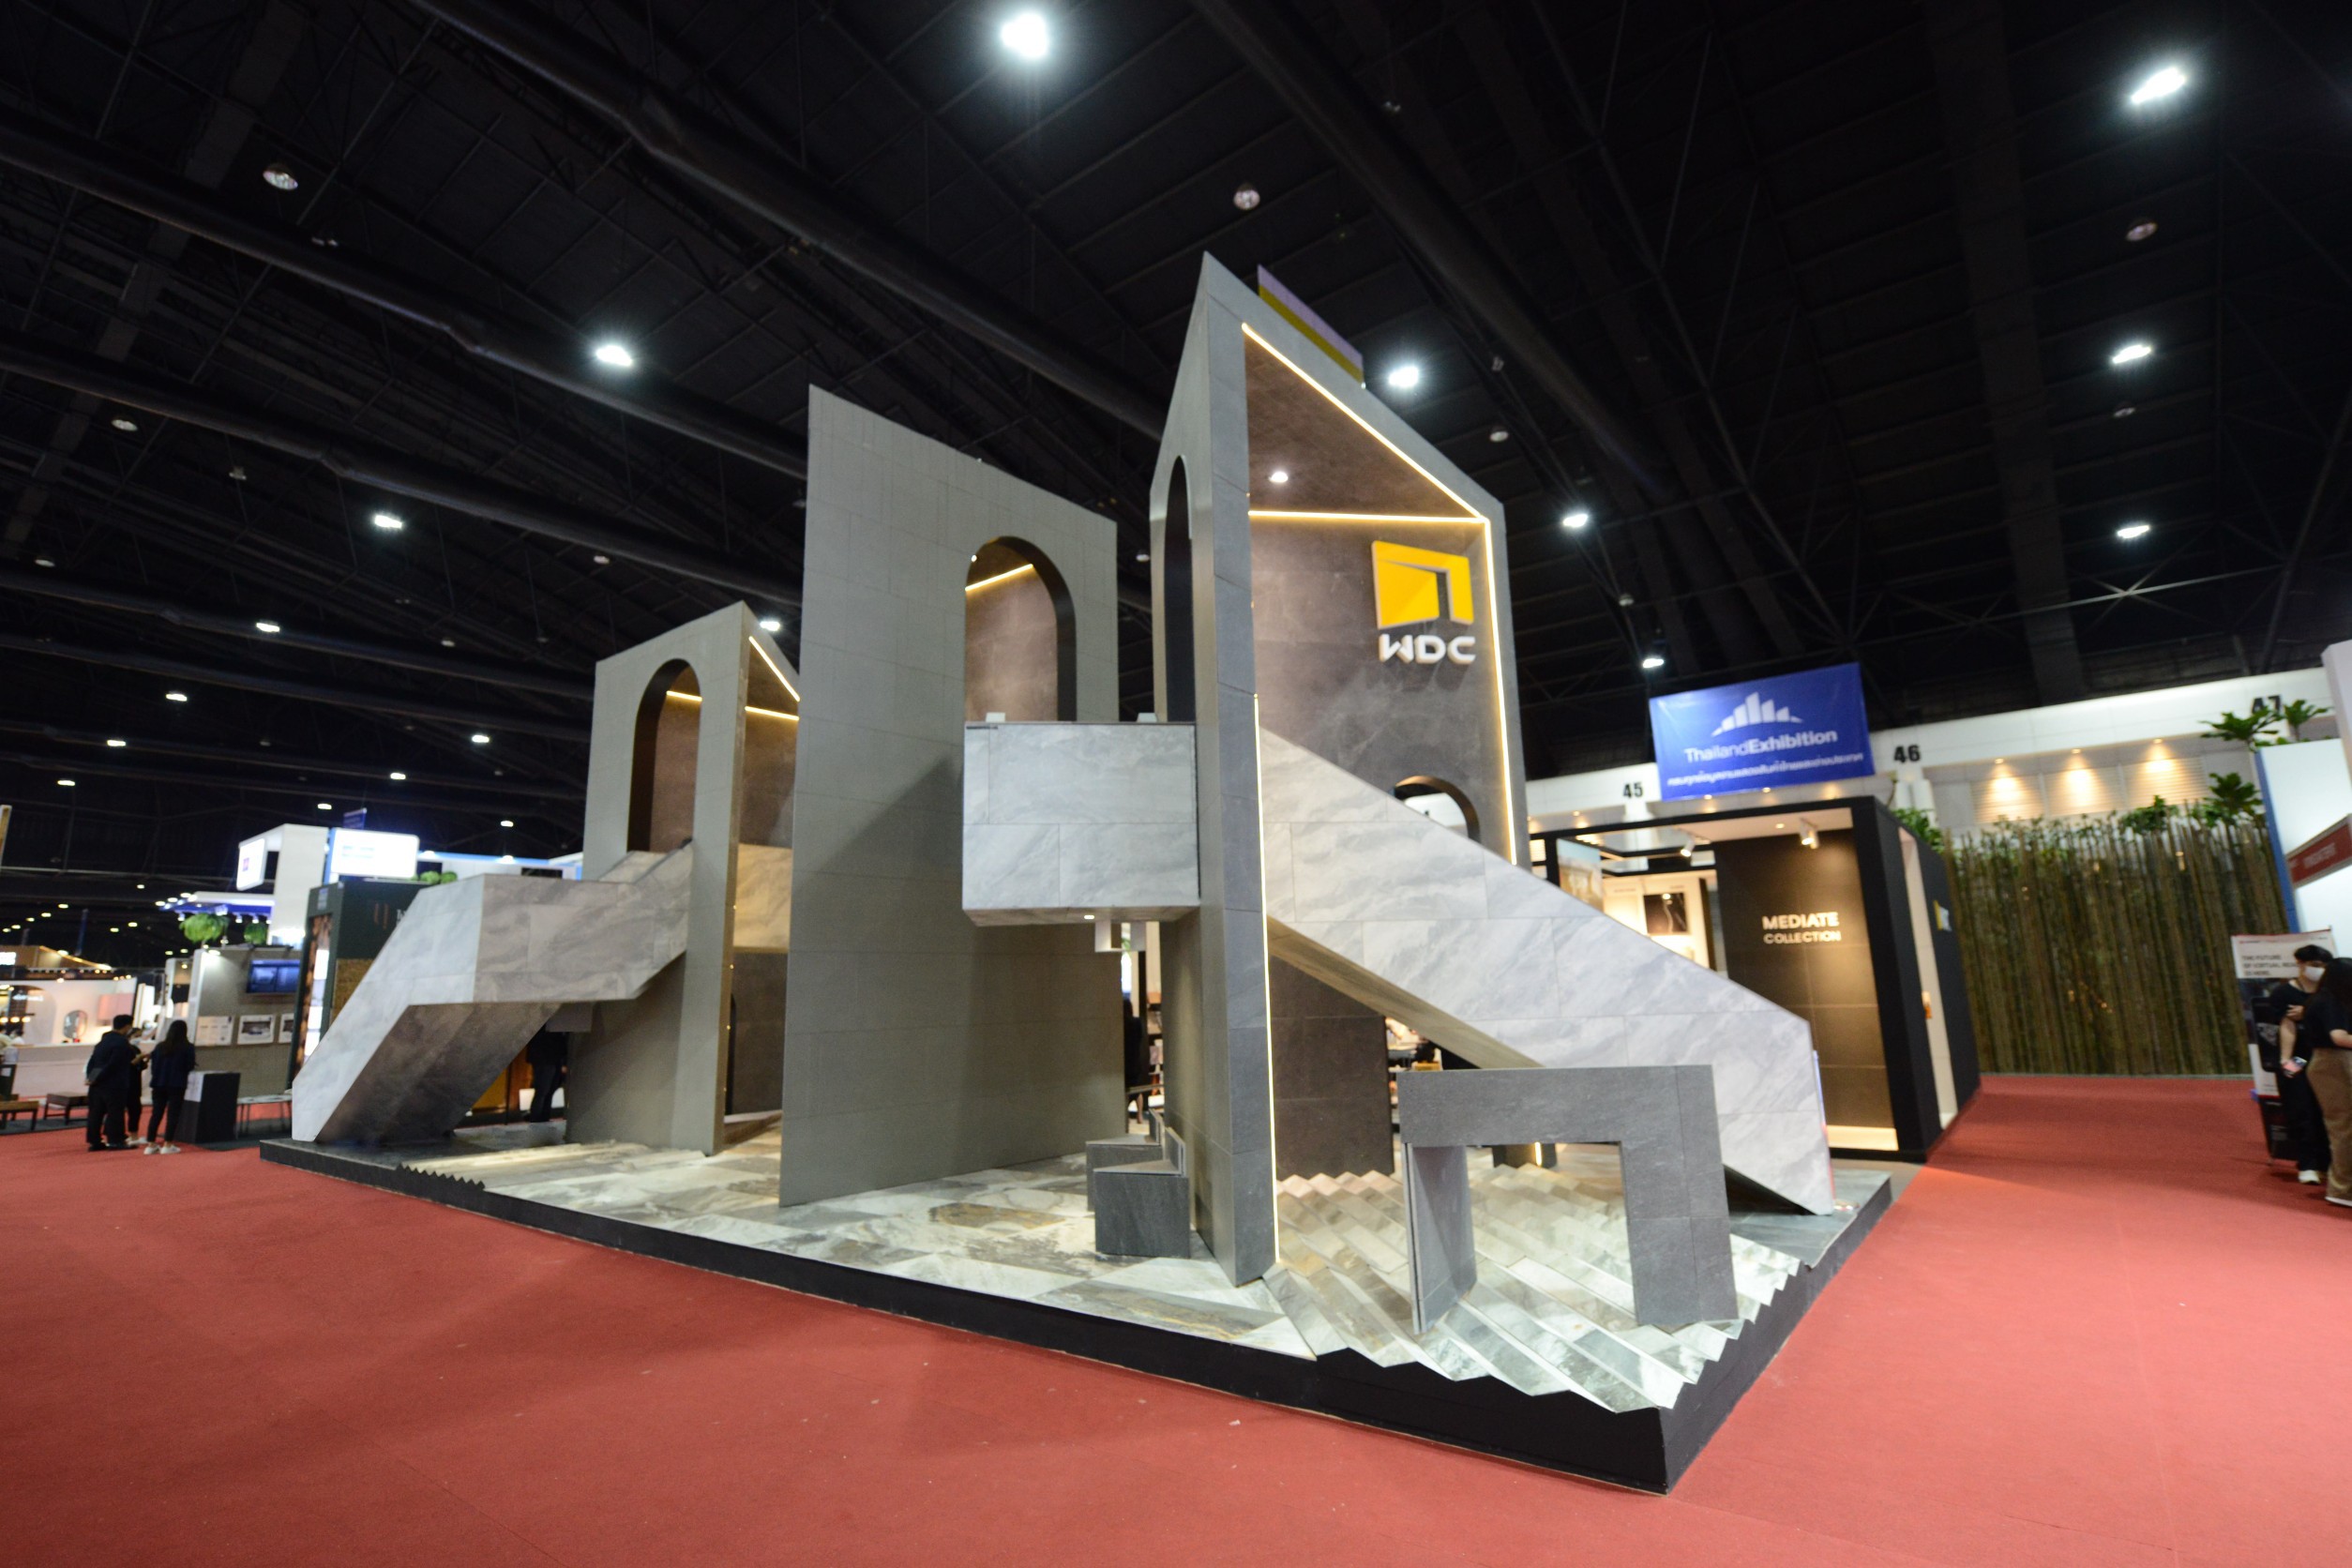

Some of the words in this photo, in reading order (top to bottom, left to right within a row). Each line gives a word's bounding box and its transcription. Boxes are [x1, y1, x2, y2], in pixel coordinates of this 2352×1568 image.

[1379, 633, 1476, 664] WDC
[1893, 745, 1921, 763] 46
[1623, 782, 1643, 798] 45
[1762, 912, 1839, 930] MEDIATE
[1763, 930, 1842, 944] COLLECTION
